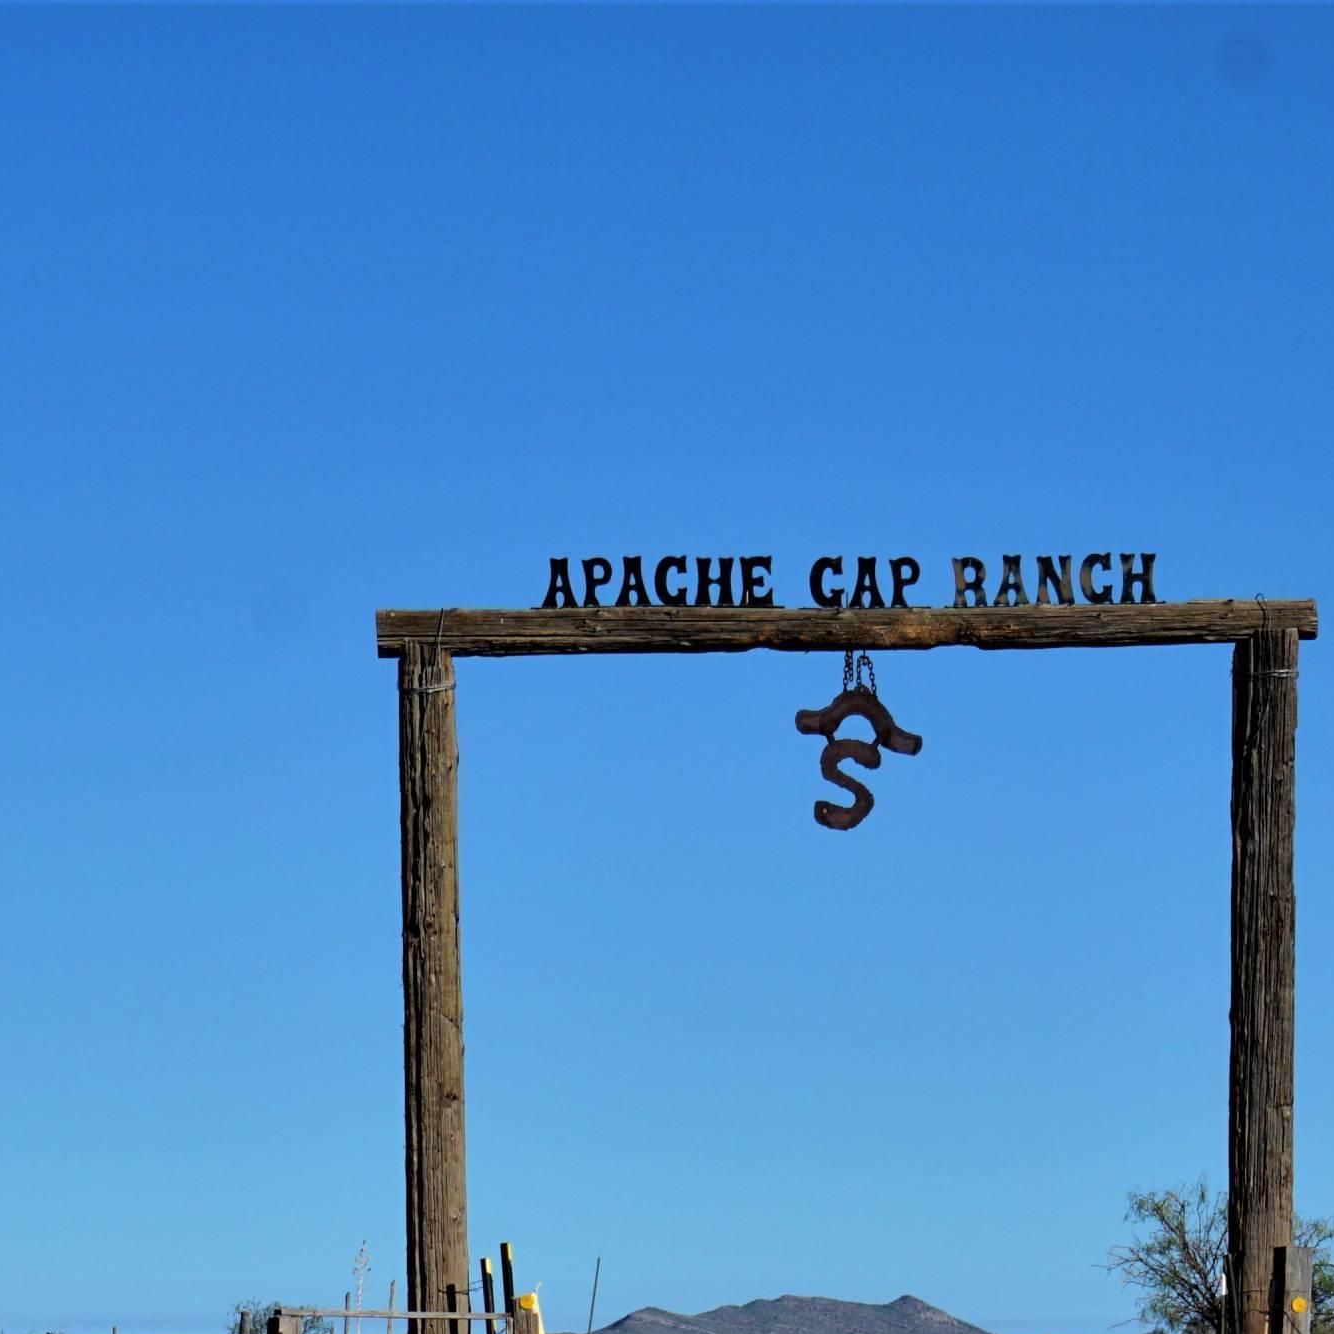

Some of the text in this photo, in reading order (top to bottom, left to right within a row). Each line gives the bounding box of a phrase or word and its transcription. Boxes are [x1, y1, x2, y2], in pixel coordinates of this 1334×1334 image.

[541, 552, 1157, 608] APACHE GAP RANCH
